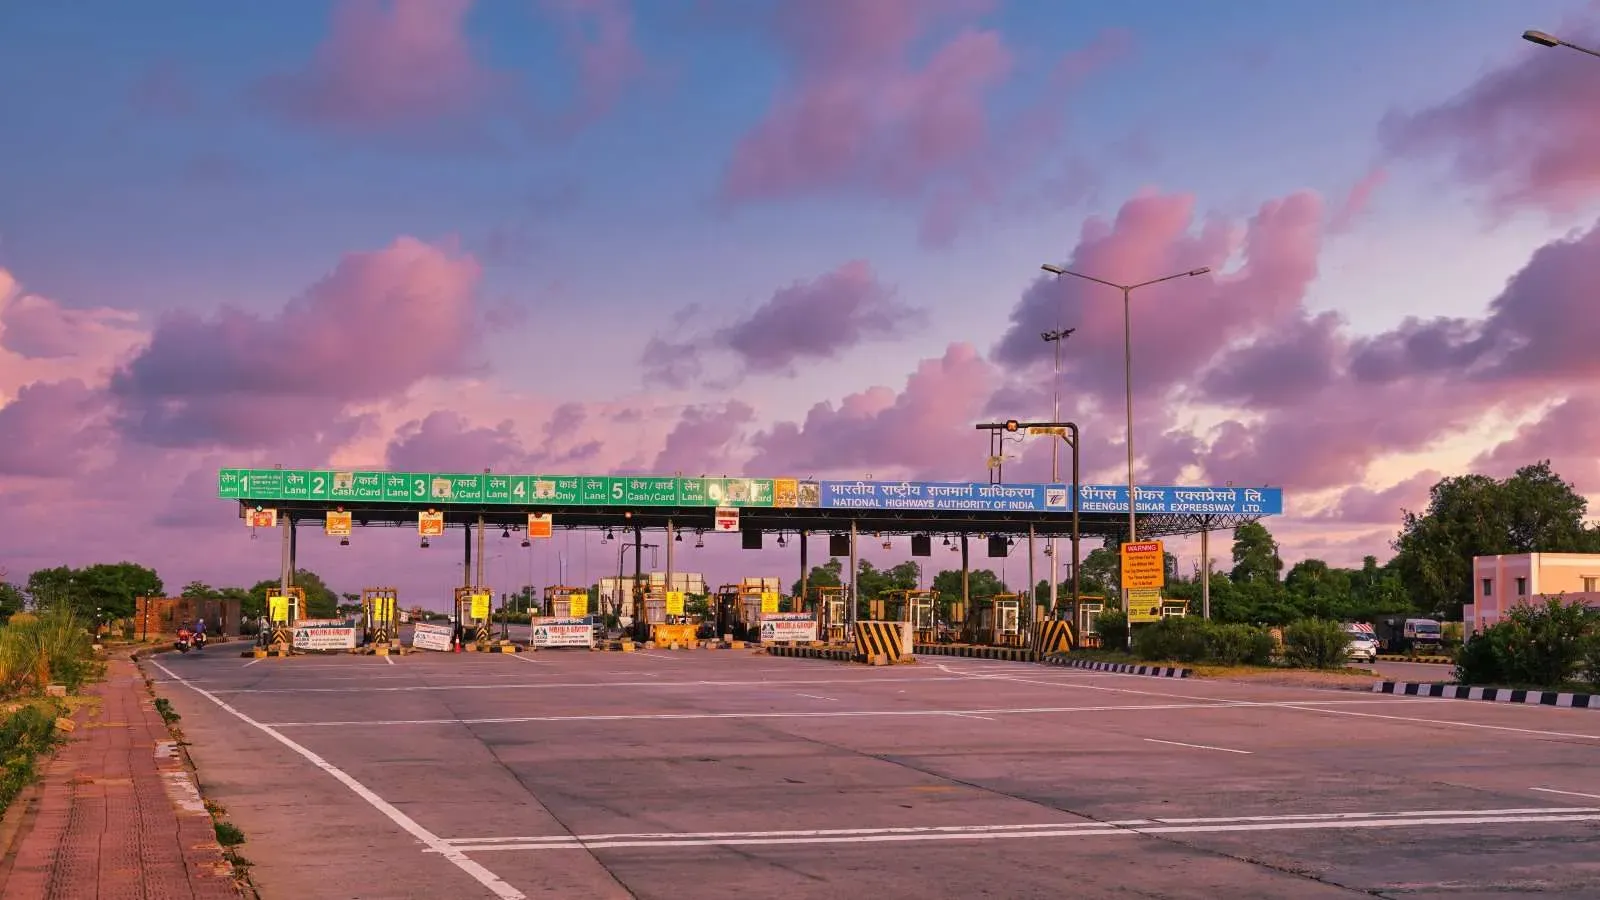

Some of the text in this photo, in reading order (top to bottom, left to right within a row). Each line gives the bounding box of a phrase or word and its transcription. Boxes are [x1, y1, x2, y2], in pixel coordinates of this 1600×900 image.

[222, 473, 236, 483] लेन
[287, 473, 304, 484] लेन
[387, 476, 404, 487] लेन
[490, 477, 506, 488] लेन
[240, 476, 248, 492] 1
[312, 477, 325, 494] 2
[414, 479, 425, 496] 3
[513, 481, 525, 498] 4
[559, 479, 577, 489] कार्ड
[587, 479, 602, 490] लेन
[684, 481, 699, 491] लेन
[284, 486, 307, 494] Lane
[387, 488, 409, 497] Lane
[486, 490, 508, 498] Lane
[612, 483, 623, 500] 5
[830, 482, 875, 495] भारतीय
[881, 483, 921, 498] राष्ट्रीय
[927, 484, 973, 497] राजमार्ग
[979, 485, 1035, 498] प्राधिकरण
[1080, 486, 1116, 500] रींगस
[1175, 489, 1236, 502] एक्सप्रेसवे
[1245, 489, 1266, 502] लि.
[556, 492, 576, 502] Only
[628, 492, 675, 502] Cash/Card
[682, 493, 703, 501] Lane
[833, 498, 1035, 510] NATIONAL HIGHWAYS AUTHORITY OF INDIA
[1082, 502, 1262, 512] REENGUS SIKAR EXPRESSWAY LTD.
